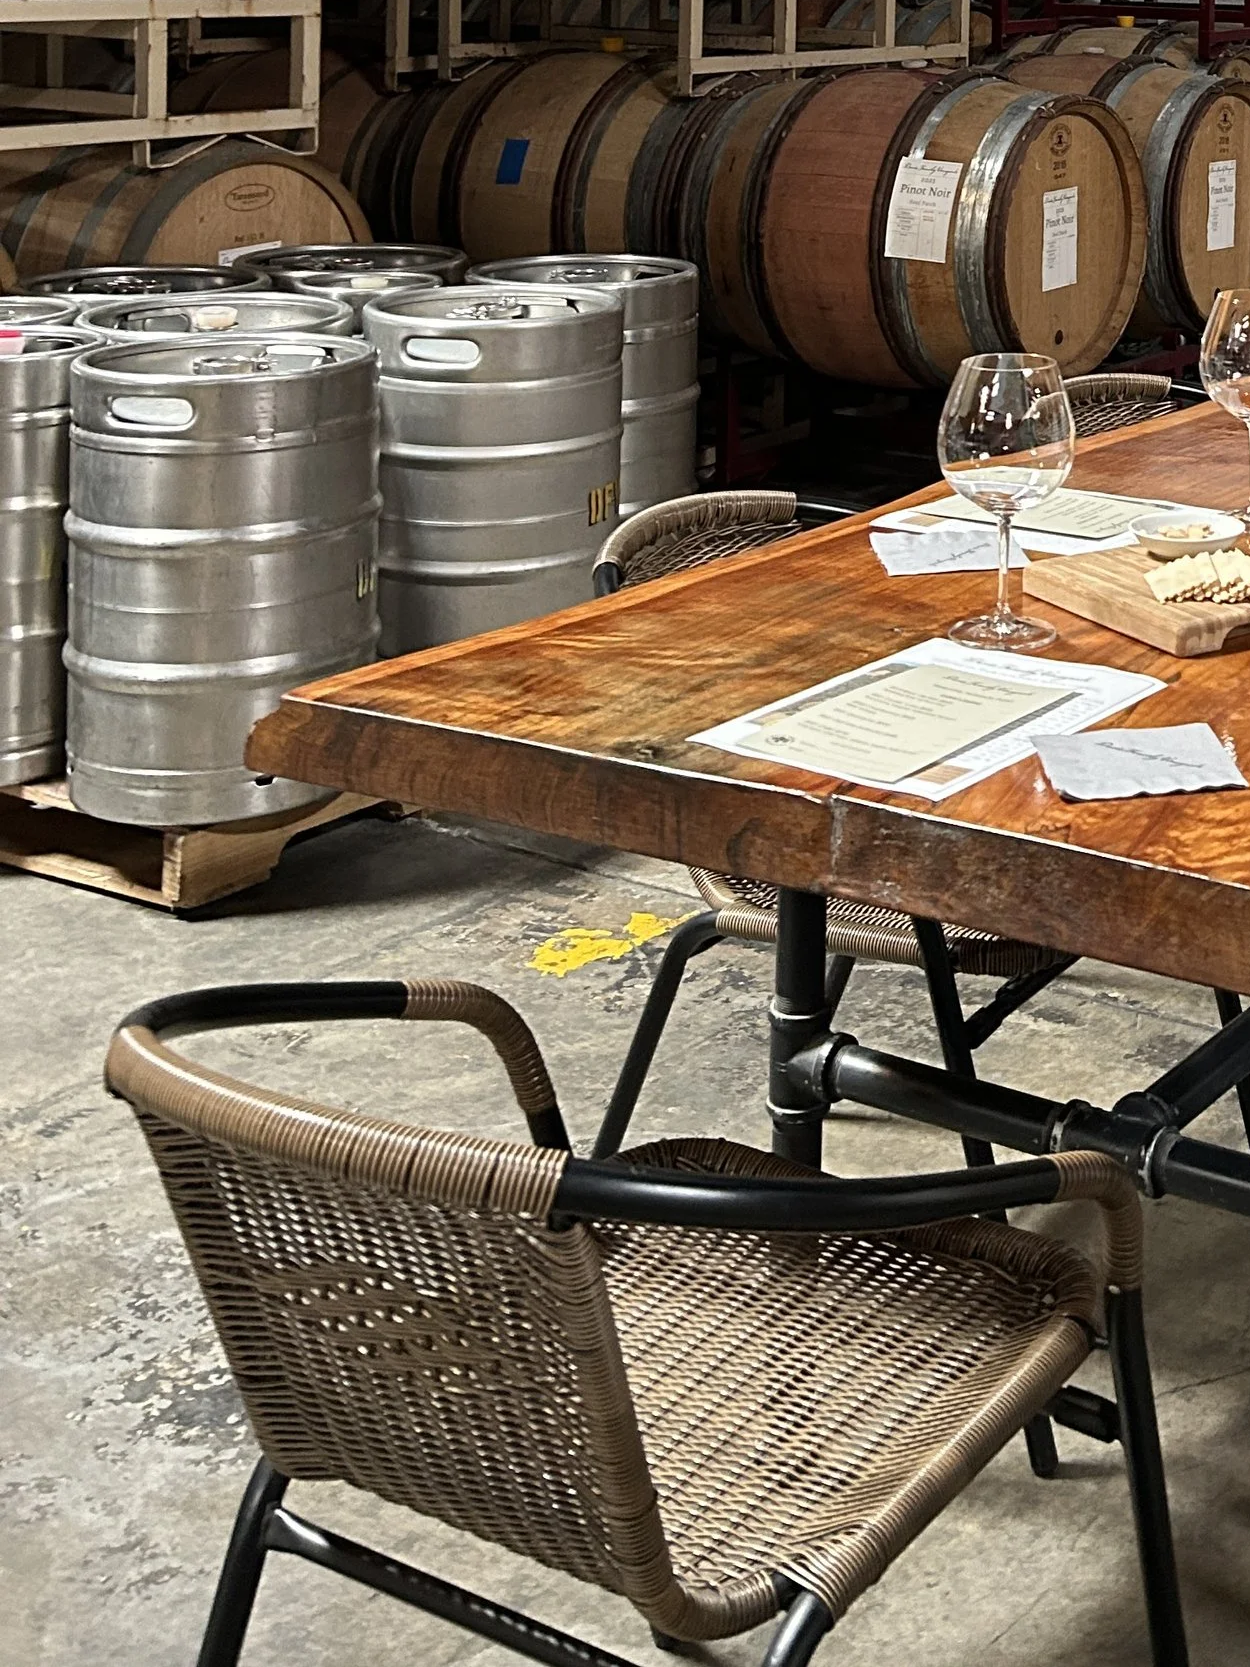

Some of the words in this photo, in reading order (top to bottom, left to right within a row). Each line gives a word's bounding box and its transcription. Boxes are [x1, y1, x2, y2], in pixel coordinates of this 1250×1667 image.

[900, 183, 926, 194] Pinot
[928, 186, 951, 198] Noir
[1045, 218, 1061, 229] Pinot
[1061, 215, 1075, 226] Noir
